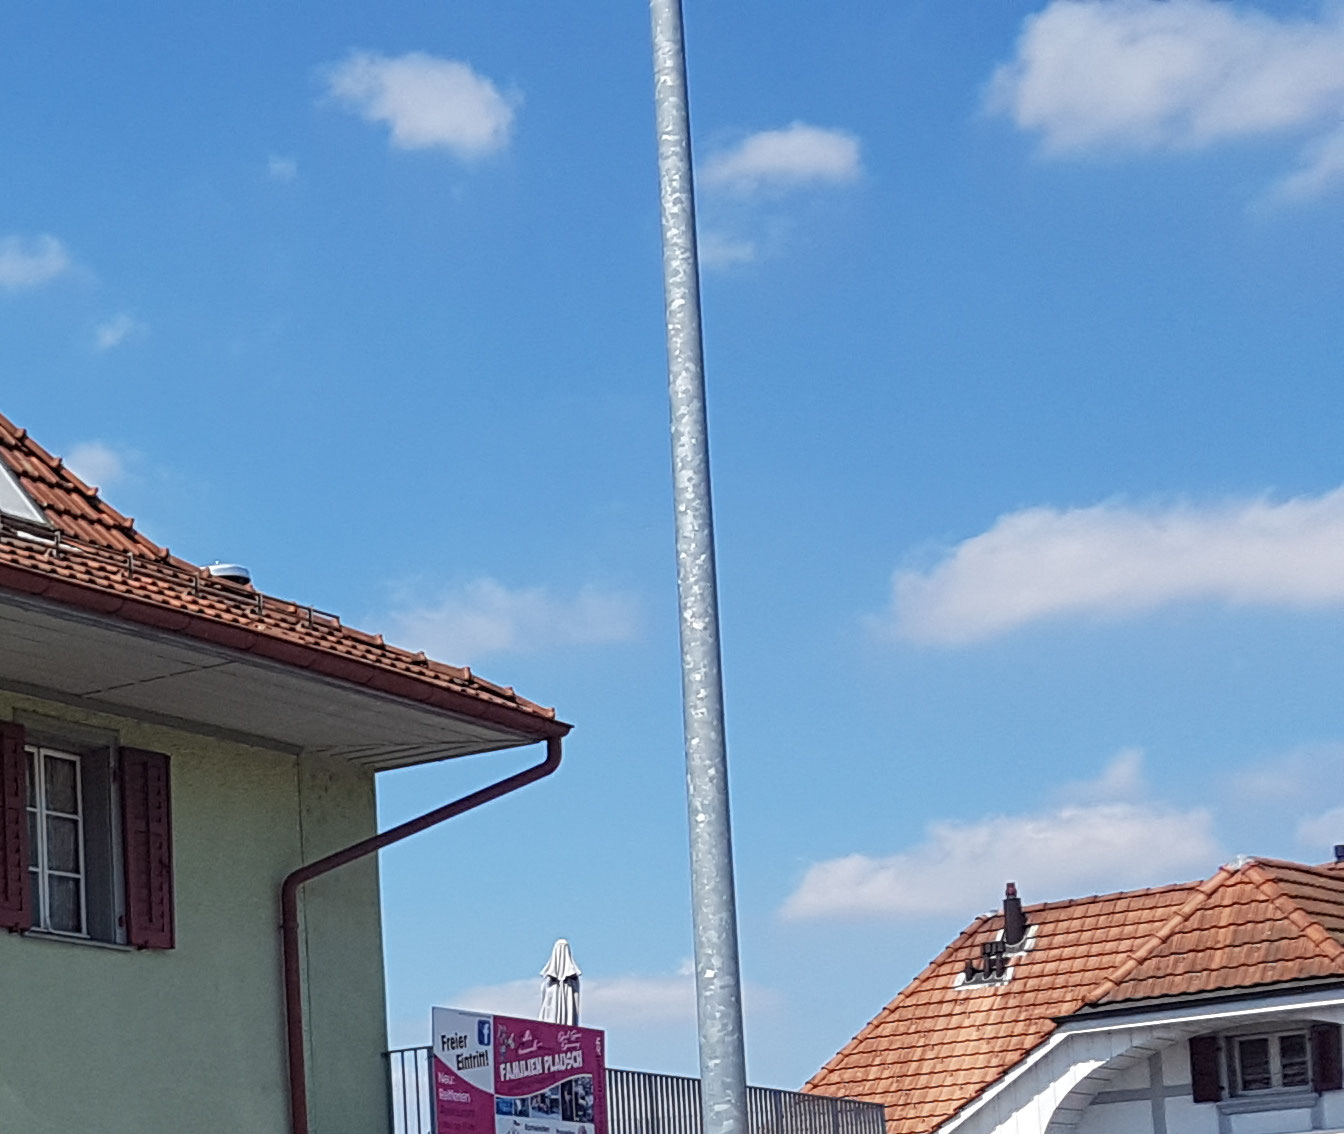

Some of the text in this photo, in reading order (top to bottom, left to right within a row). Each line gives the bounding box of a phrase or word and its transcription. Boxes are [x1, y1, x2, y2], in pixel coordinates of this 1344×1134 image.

[441, 1032, 467, 1052] Freier
[456, 1049, 489, 1071] Eintritt!
[499, 1050, 583, 1081] FAMILIEN PLAUSCH
